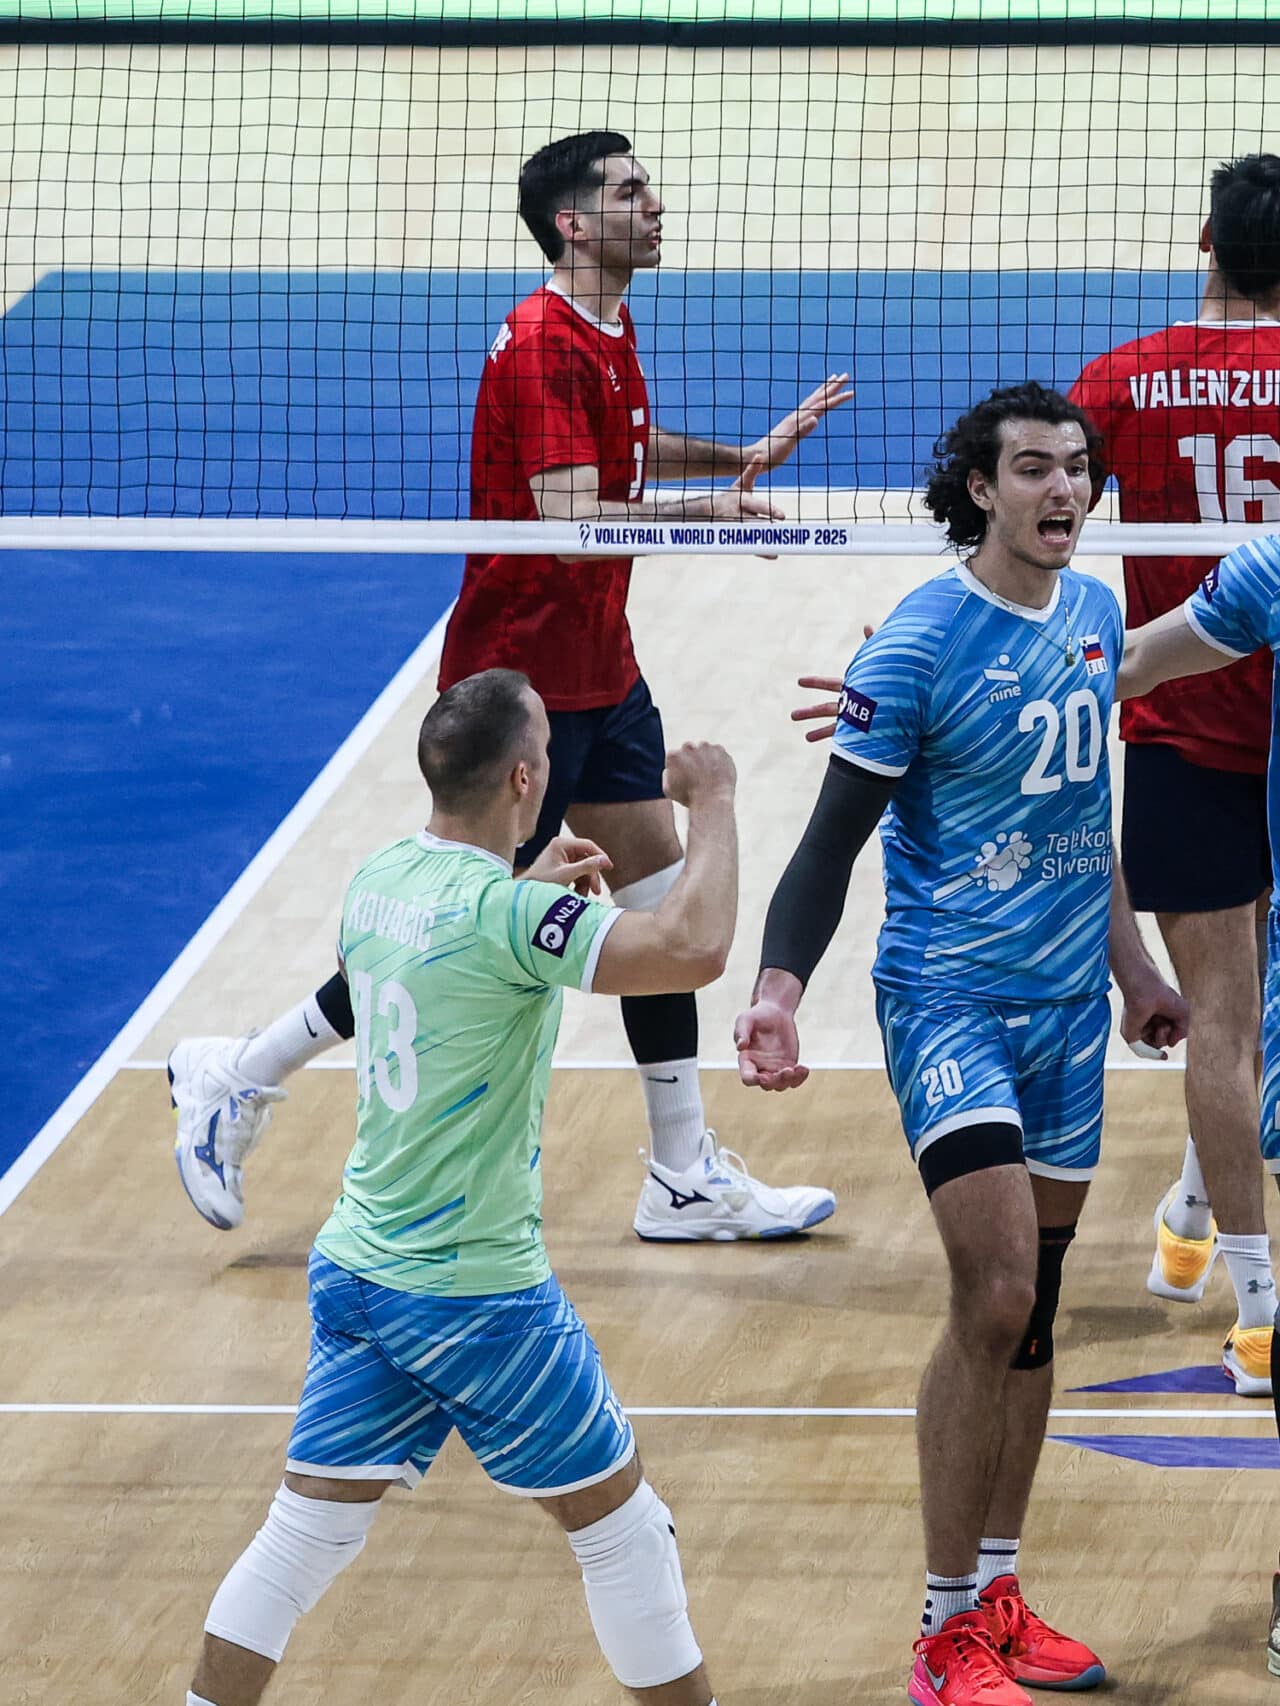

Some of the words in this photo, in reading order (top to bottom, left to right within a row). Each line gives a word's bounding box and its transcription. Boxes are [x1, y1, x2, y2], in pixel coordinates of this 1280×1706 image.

[595, 528, 665, 545] VOLLEYBALL
[670, 528, 714, 545] WORLD
[719, 528, 810, 545] CHAMPIONSHIP
[814, 528, 848, 545] 2025
[846, 699, 870, 722] NLB
[989, 685, 1022, 704] nine
[1018, 688, 1102, 796] 20
[352, 969, 419, 1113] 13
[919, 1058, 964, 1107] 20
